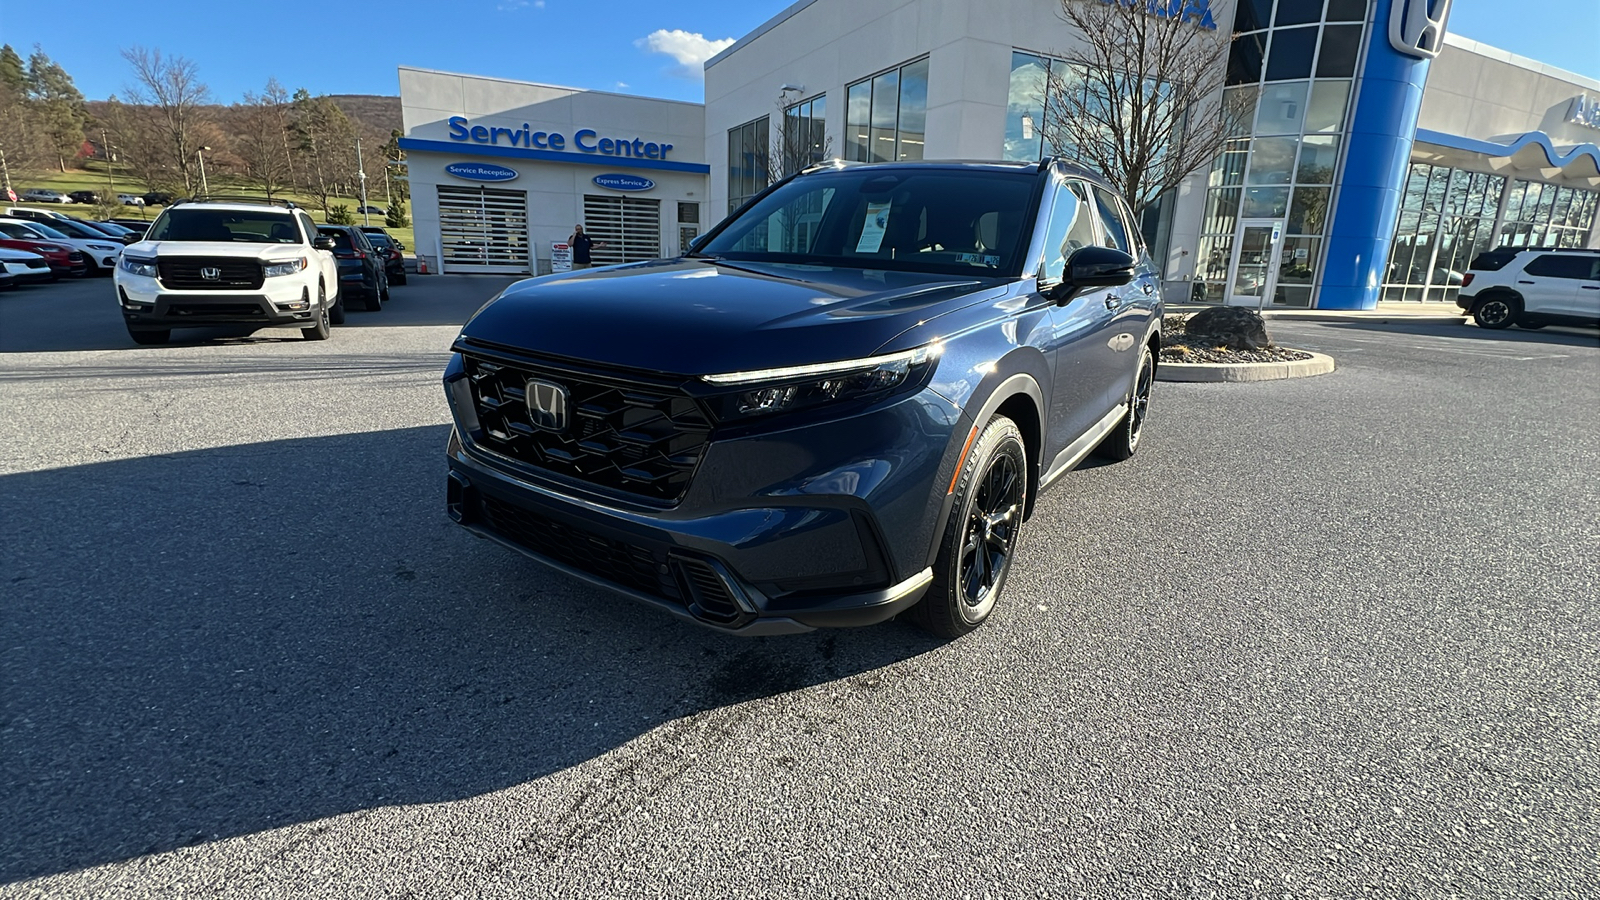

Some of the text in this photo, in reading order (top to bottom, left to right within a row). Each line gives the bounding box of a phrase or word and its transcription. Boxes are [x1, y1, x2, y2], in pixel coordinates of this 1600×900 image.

[448, 116, 673, 160] Service Center
[450, 166, 514, 177] Service Reception
[596, 177, 620, 186] Express
